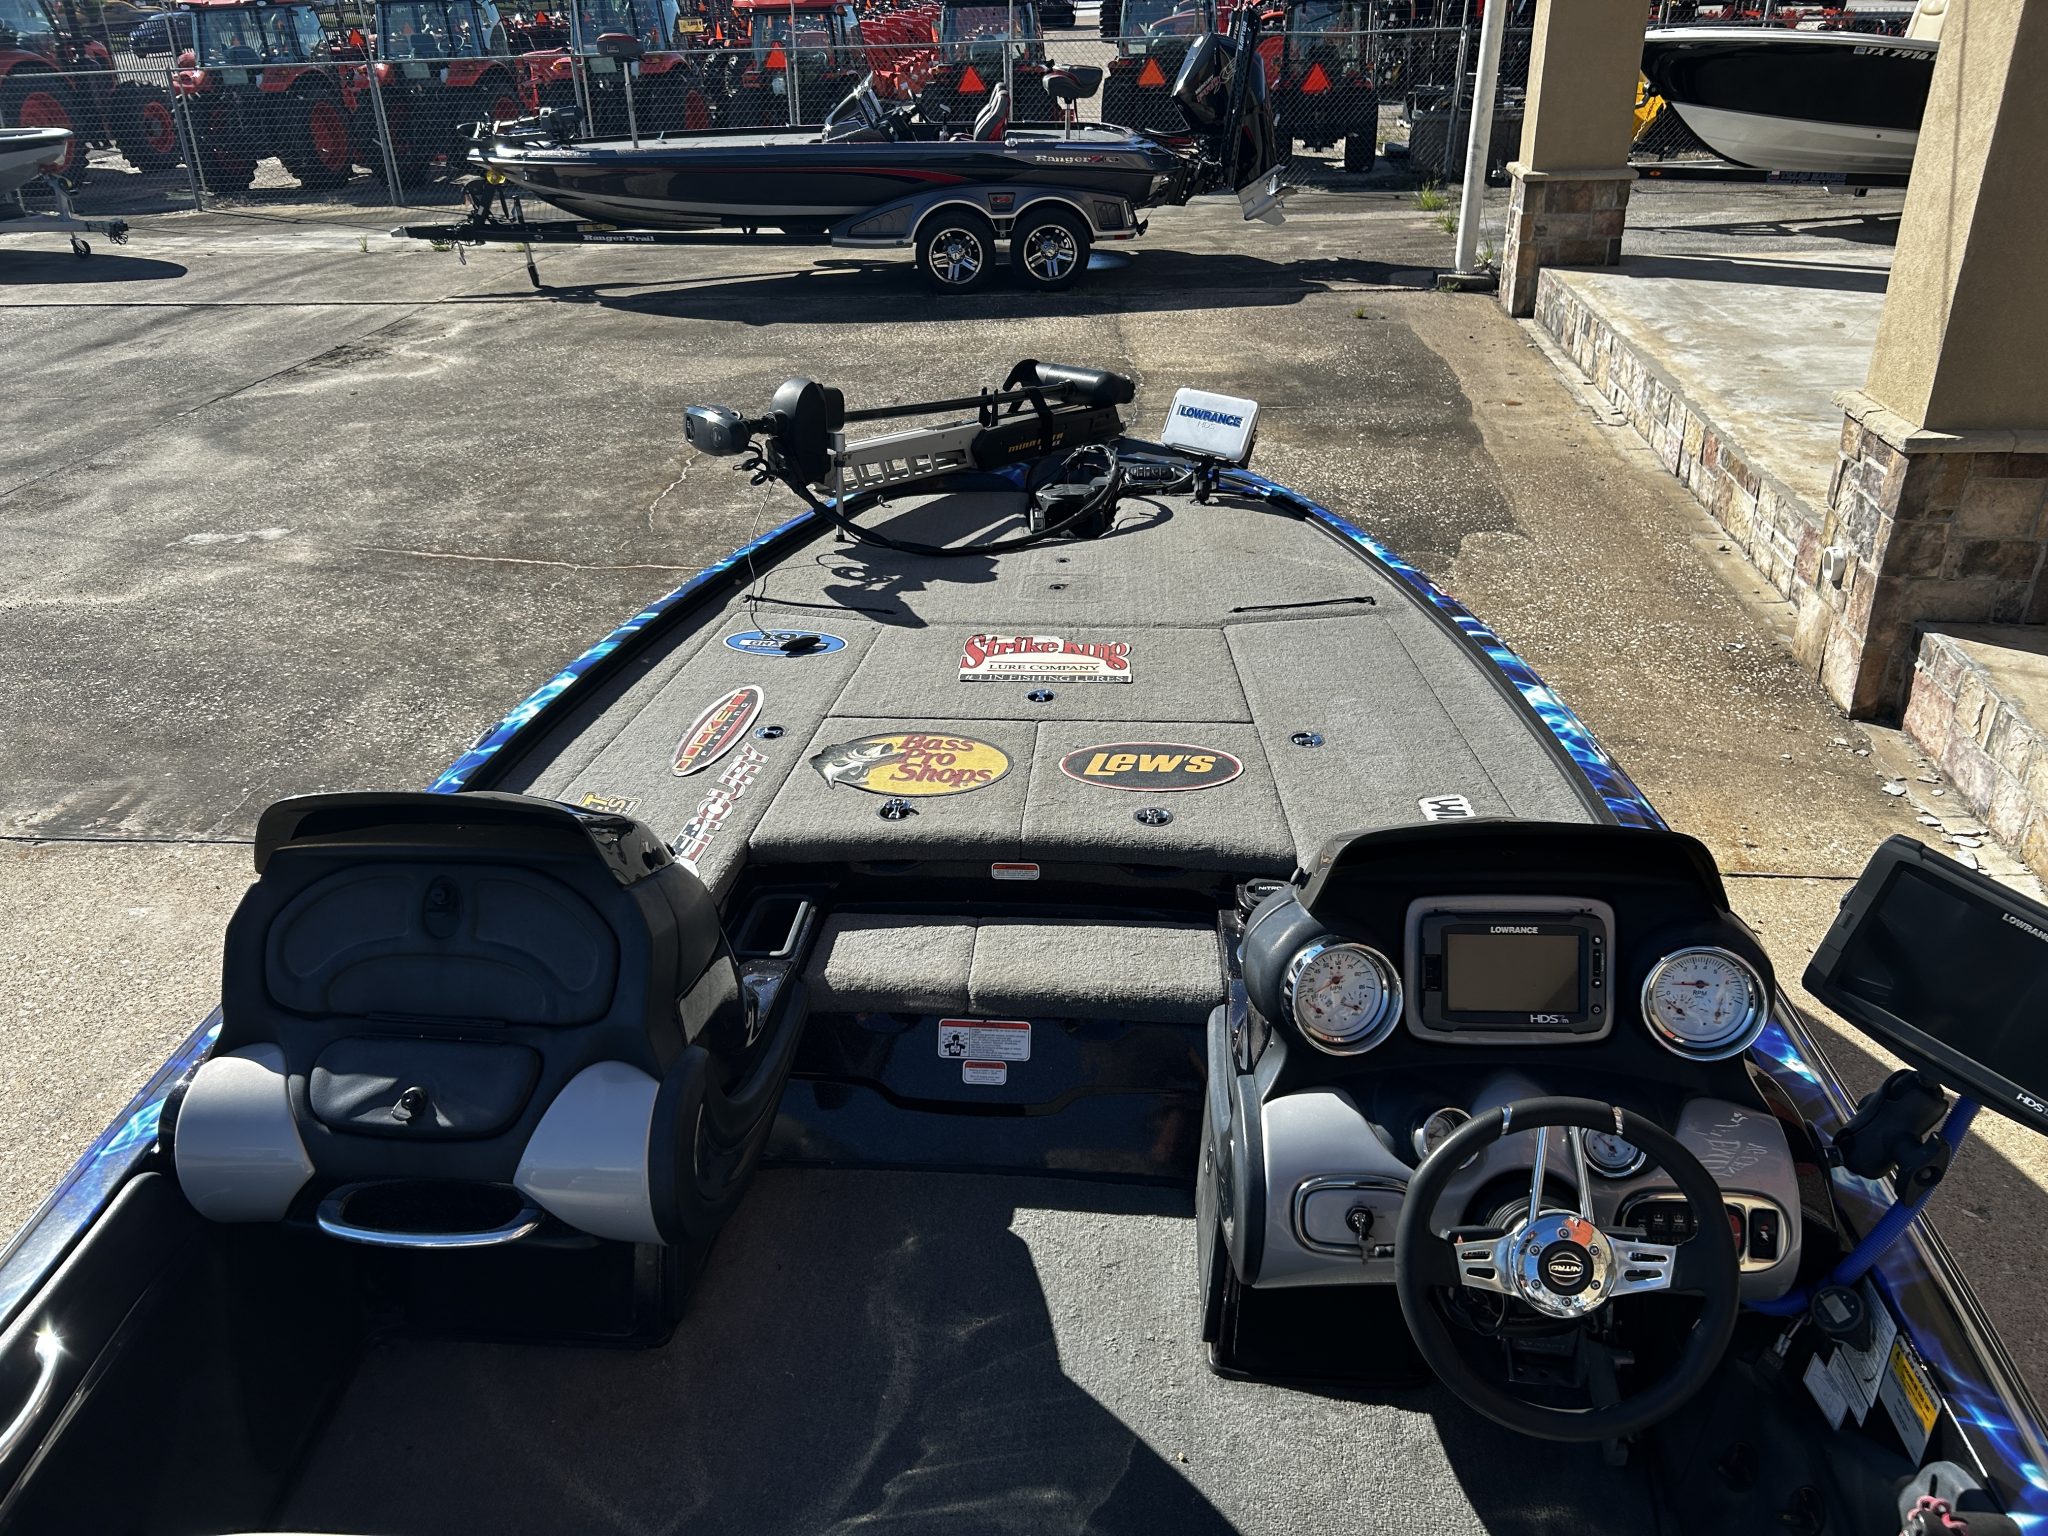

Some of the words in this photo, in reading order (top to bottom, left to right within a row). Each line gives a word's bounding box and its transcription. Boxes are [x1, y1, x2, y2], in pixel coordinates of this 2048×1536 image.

[1866, 47, 1888, 56] TX
[1889, 49, 1929, 60] 7916
[1034, 155, 1091, 164] Ranger
[583, 234, 625, 242] Ranger
[1180, 405, 1243, 428] LOWRANCE
[960, 634, 1059, 669] Strike
[1058, 640, 1128, 670] King
[1008, 674, 1070, 682] FISHING
[672, 690, 750, 771] DUCKETT
[897, 734, 976, 751] Bass
[899, 748, 956, 766] Pro
[1083, 753, 1217, 776] Lew's
[889, 763, 993, 787] Shops
[670, 742, 770, 878] ERCURY
[1490, 926, 1539, 934] LOWRANCE
